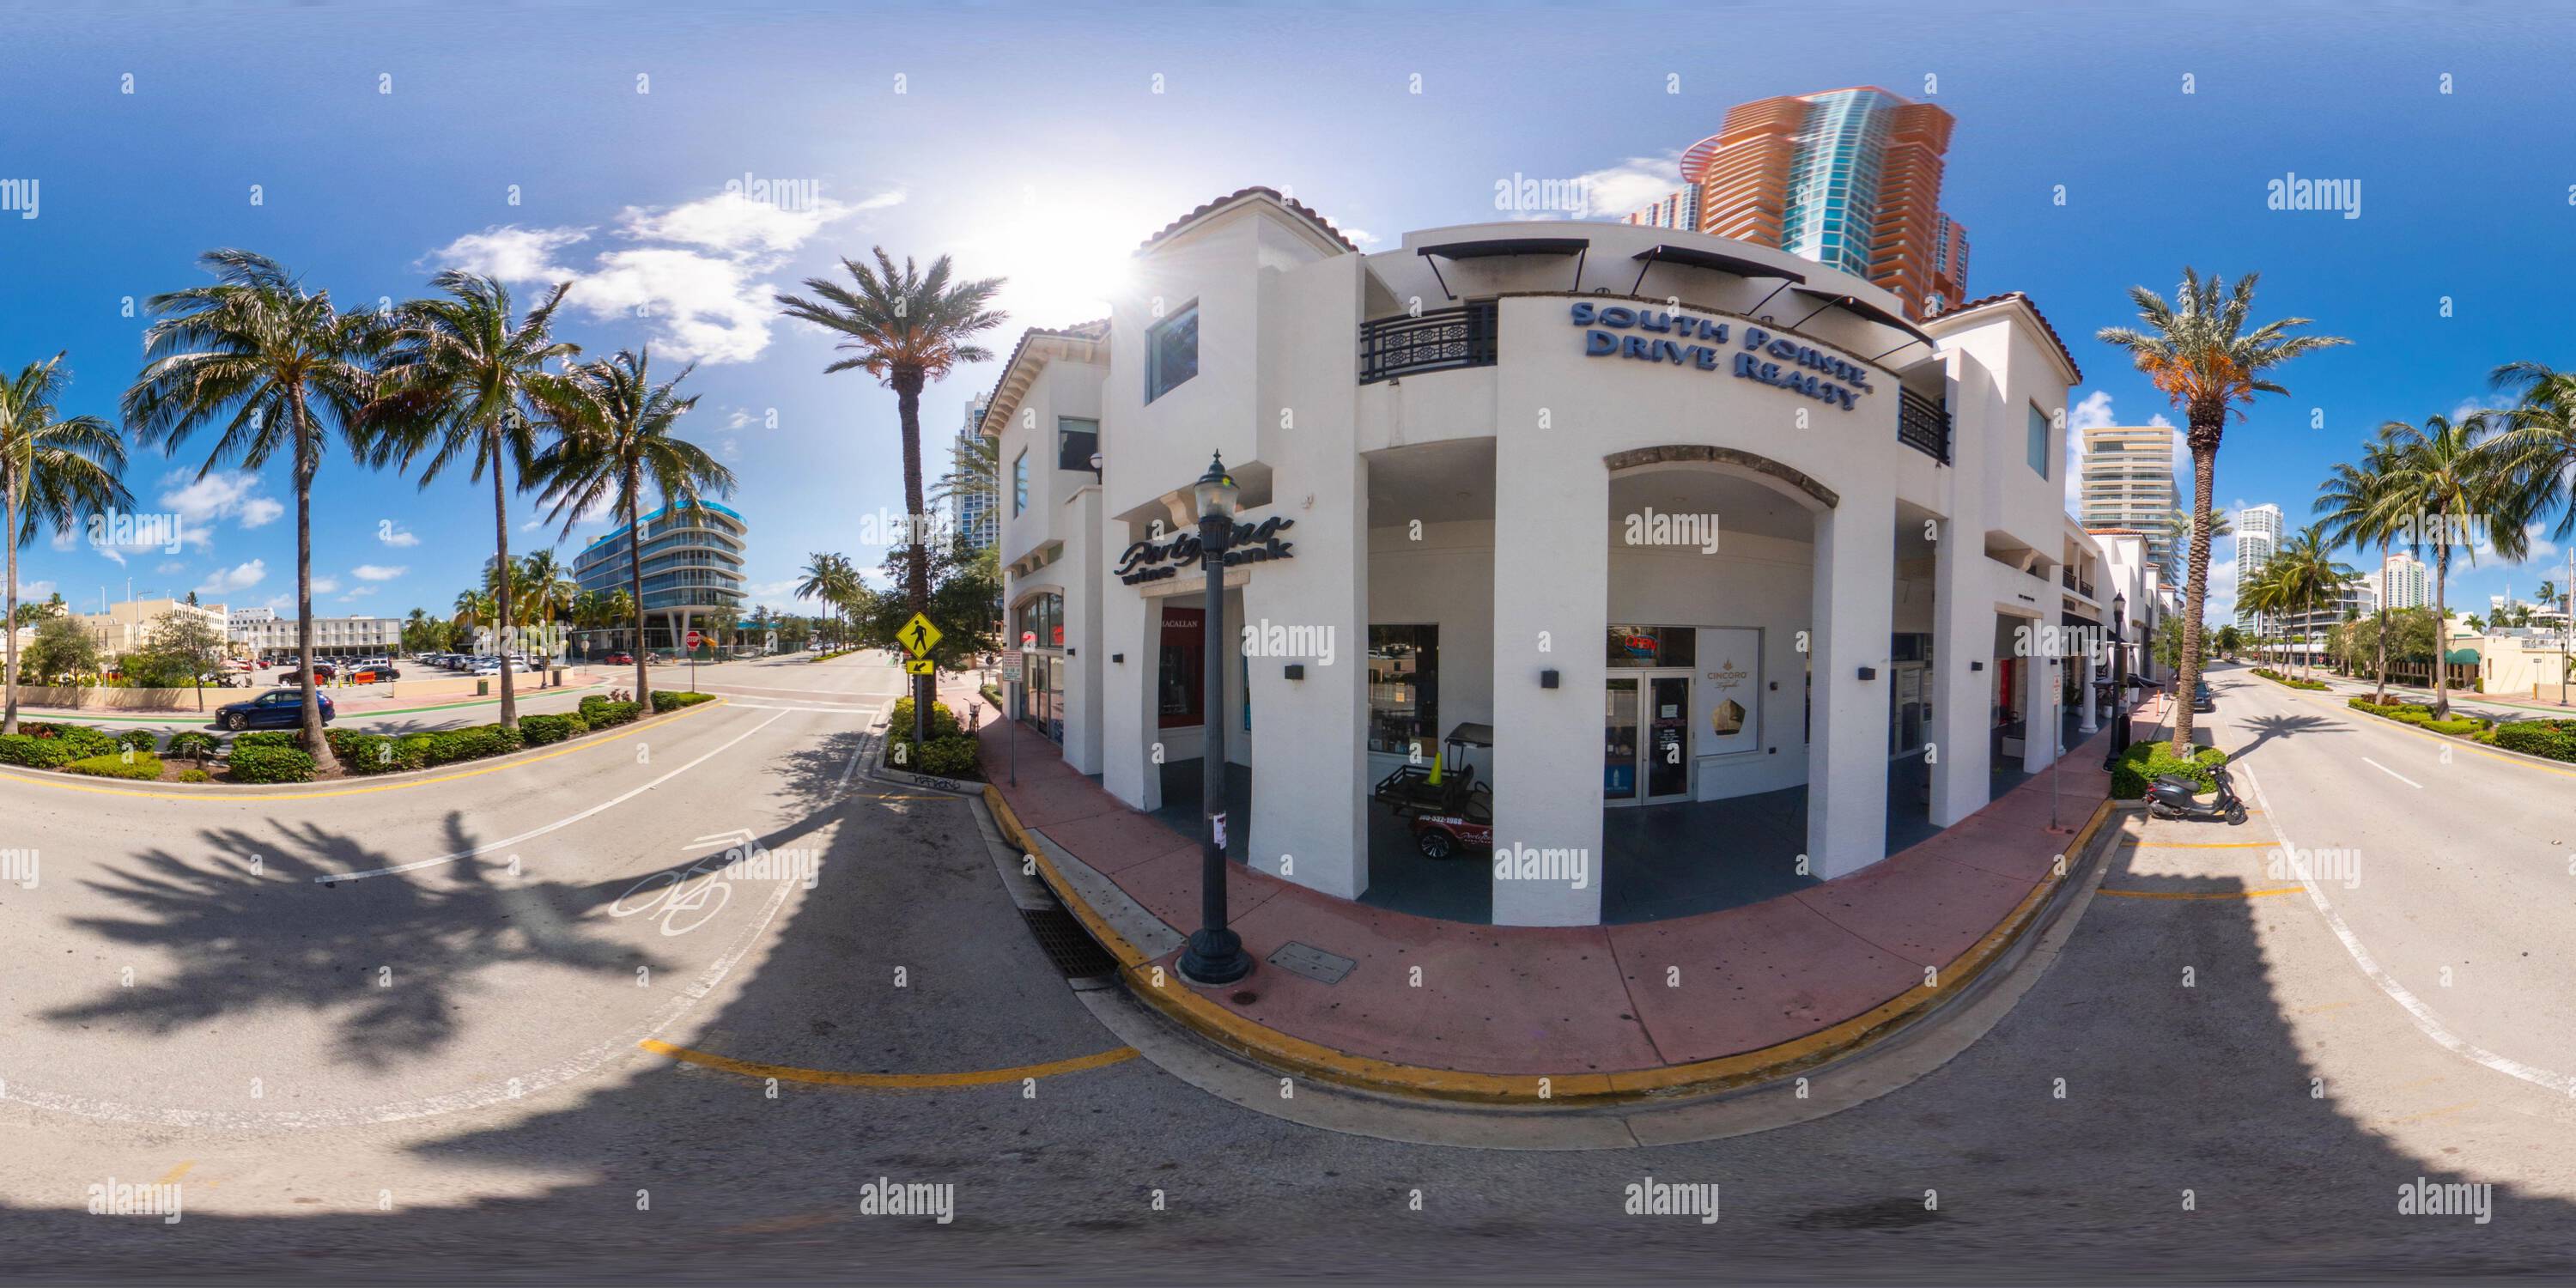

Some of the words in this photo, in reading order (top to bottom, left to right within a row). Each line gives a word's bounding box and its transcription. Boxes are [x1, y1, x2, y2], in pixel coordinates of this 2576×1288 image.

[1571, 302, 1729, 343] SOUTH
[1586, 330, 1719, 371] DRIVE
[1734, 352, 1861, 411] REALTY
[1625, 635, 1656, 650] OPEN
